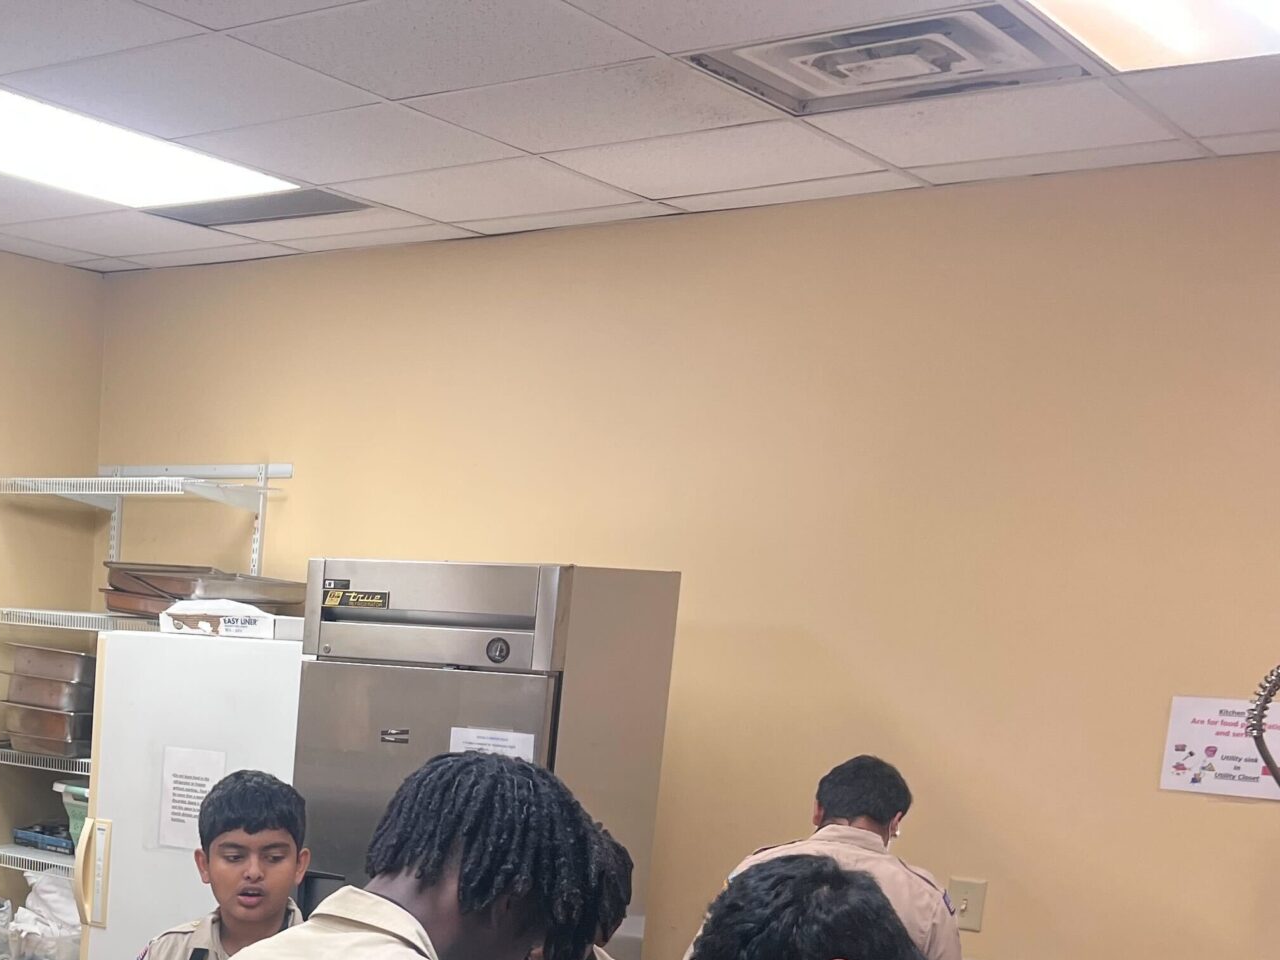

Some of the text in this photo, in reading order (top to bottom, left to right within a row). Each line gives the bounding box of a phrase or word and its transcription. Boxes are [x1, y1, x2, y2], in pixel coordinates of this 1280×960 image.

[345, 591, 383, 602] true
[223, 617, 257, 626] EASY LINER
[1219, 709, 1246, 717] Kitchen
[1207, 718, 1218, 726] for
[1220, 719, 1239, 728] food
[1220, 754, 1243, 763] Utility
[1214, 772, 1260, 782] Utility Closet
